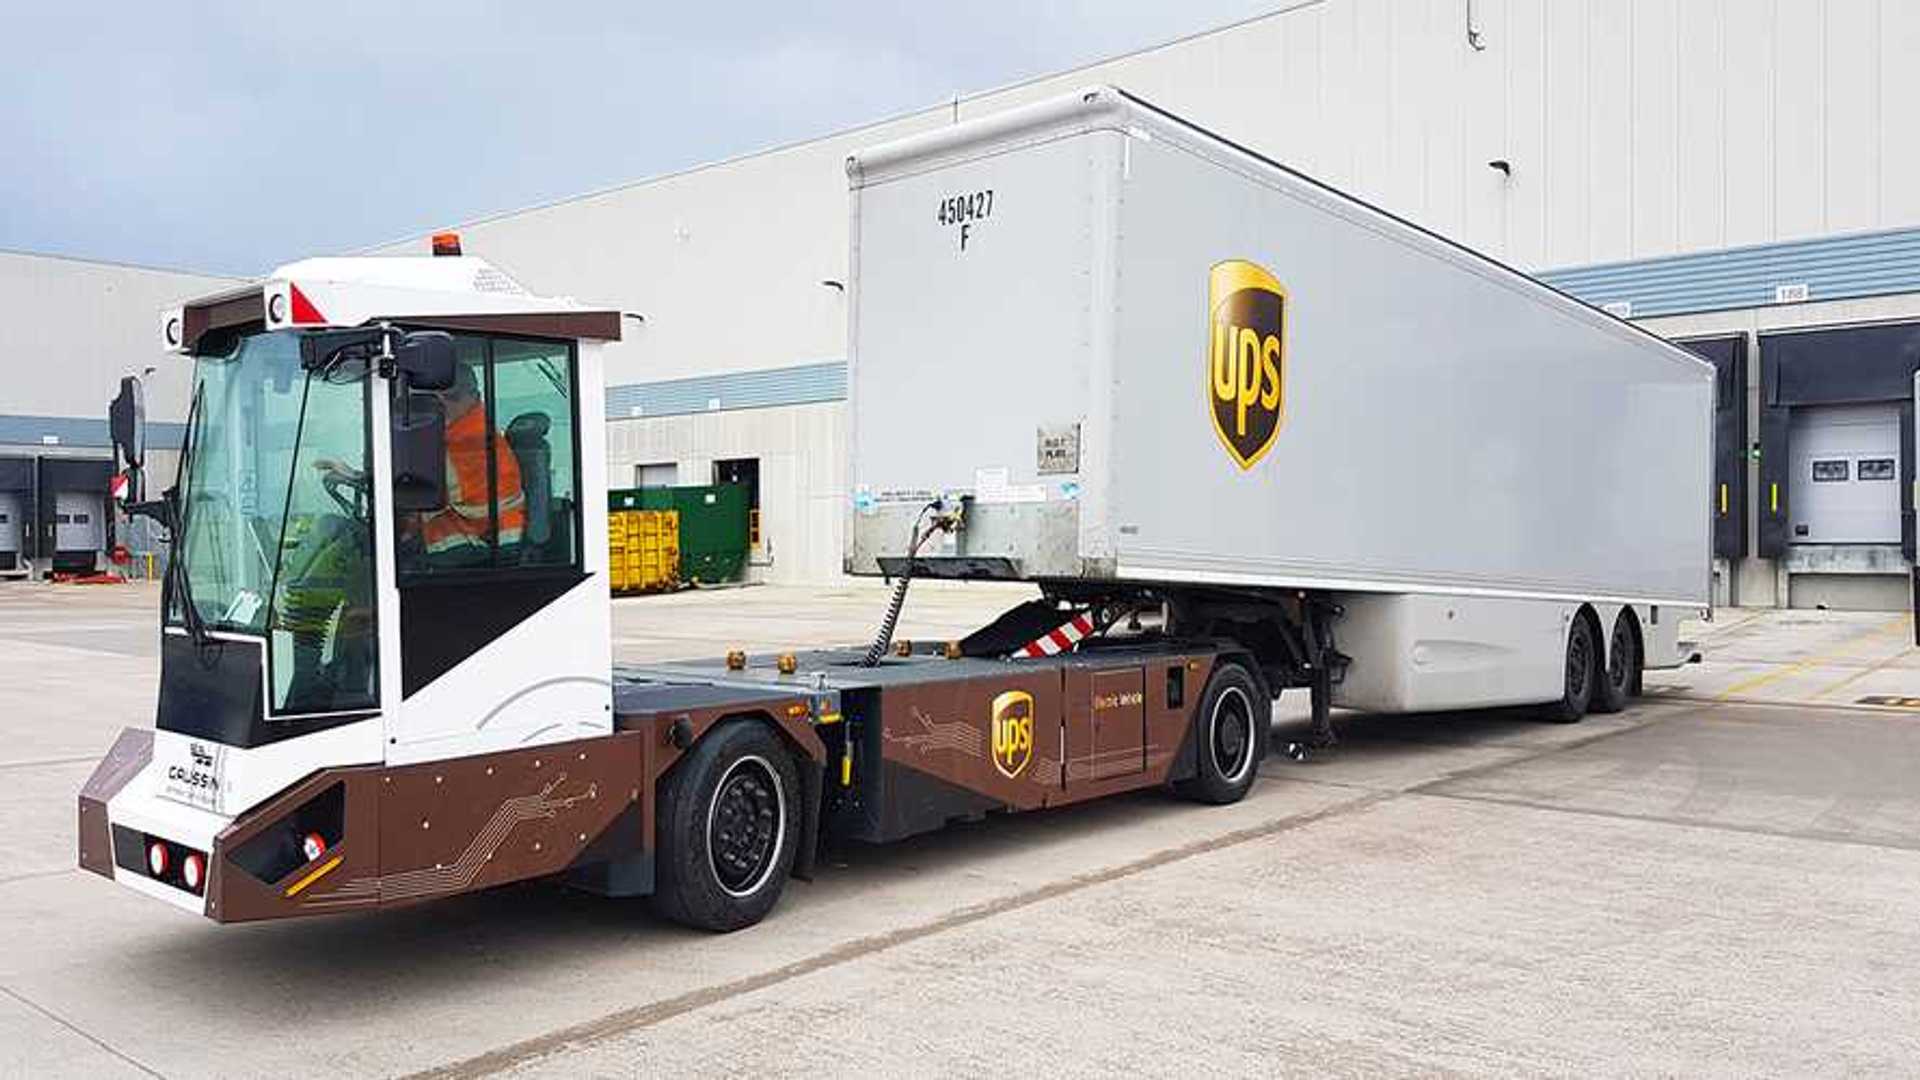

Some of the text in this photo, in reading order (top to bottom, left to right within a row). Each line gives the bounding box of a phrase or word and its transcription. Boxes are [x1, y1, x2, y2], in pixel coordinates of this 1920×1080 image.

[938, 190, 993, 226] 450427
[961, 224, 971, 252] F
[1214, 324, 1280, 436] ups
[996, 718, 1029, 765] ups
